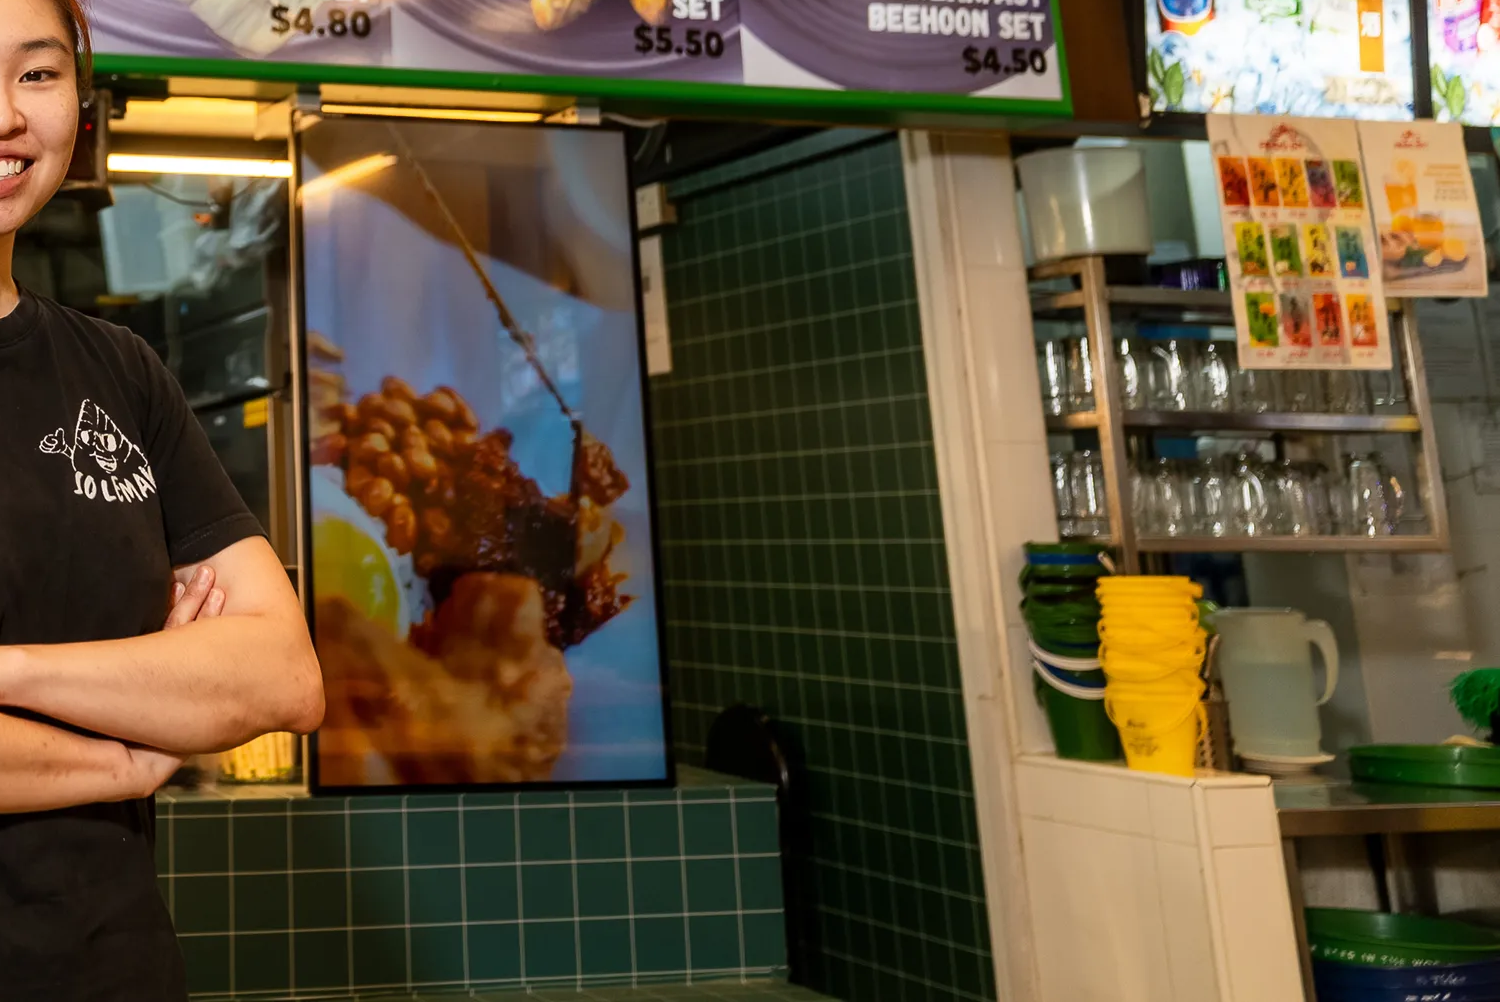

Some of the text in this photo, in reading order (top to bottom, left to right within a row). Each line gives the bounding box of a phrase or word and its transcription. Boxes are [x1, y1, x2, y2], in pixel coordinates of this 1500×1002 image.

[270, 4, 371, 39] $4.80
[867, 2, 1046, 42] BEEHOON SET
[634, 24, 725, 59] $5.50
[961, 44, 1048, 76] $4.50
[74, 470, 98, 500] SO
